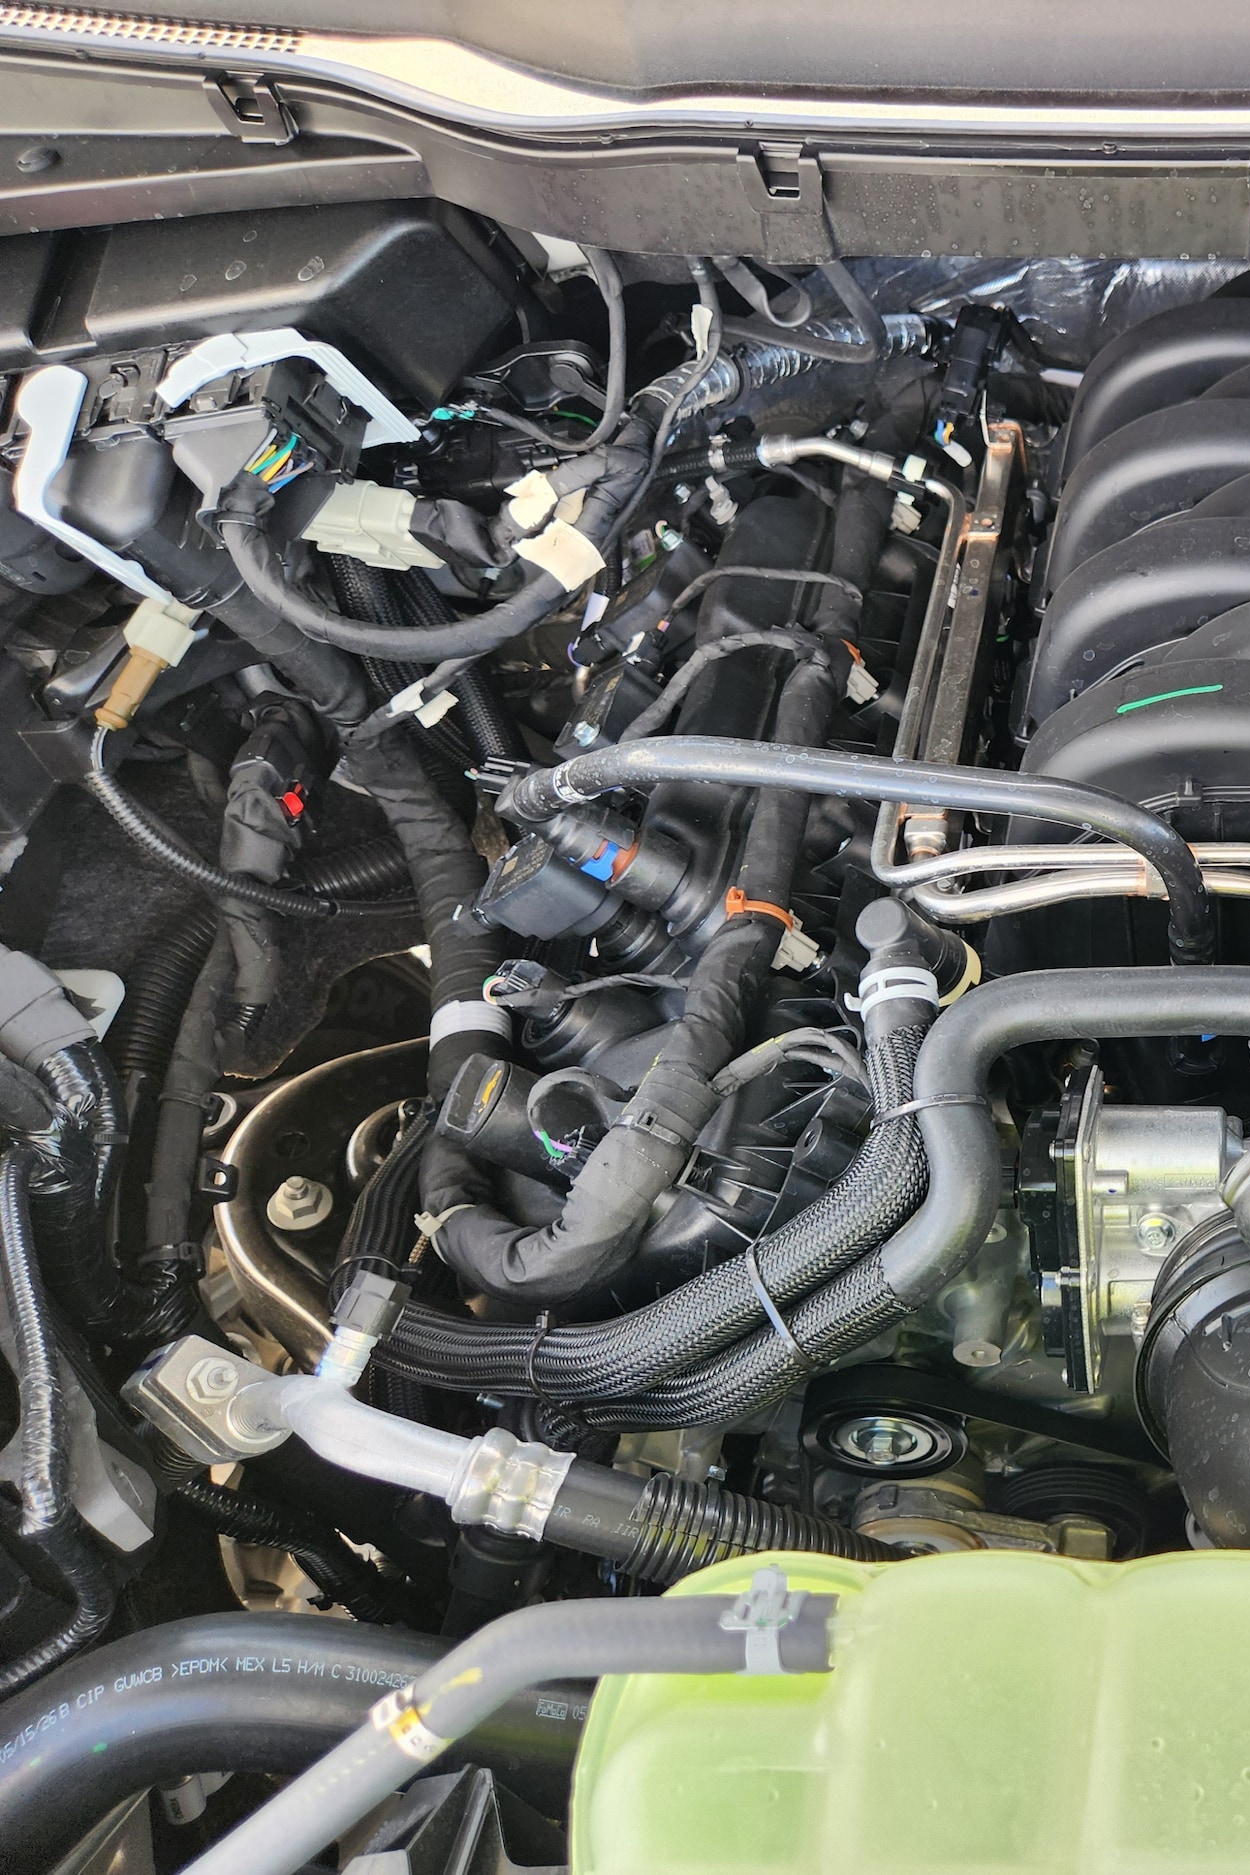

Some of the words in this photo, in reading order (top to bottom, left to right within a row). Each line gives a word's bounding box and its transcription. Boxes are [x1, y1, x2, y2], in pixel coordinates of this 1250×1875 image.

[582, 1514, 600, 1528] PA
[77, 1685, 105, 1709] CIP
[114, 1666, 163, 1693] GUWCB
[235, 1657, 265, 1672] MEX
[331, 1664, 341, 1679] C
[537, 1699, 568, 1720] FoMoCo
